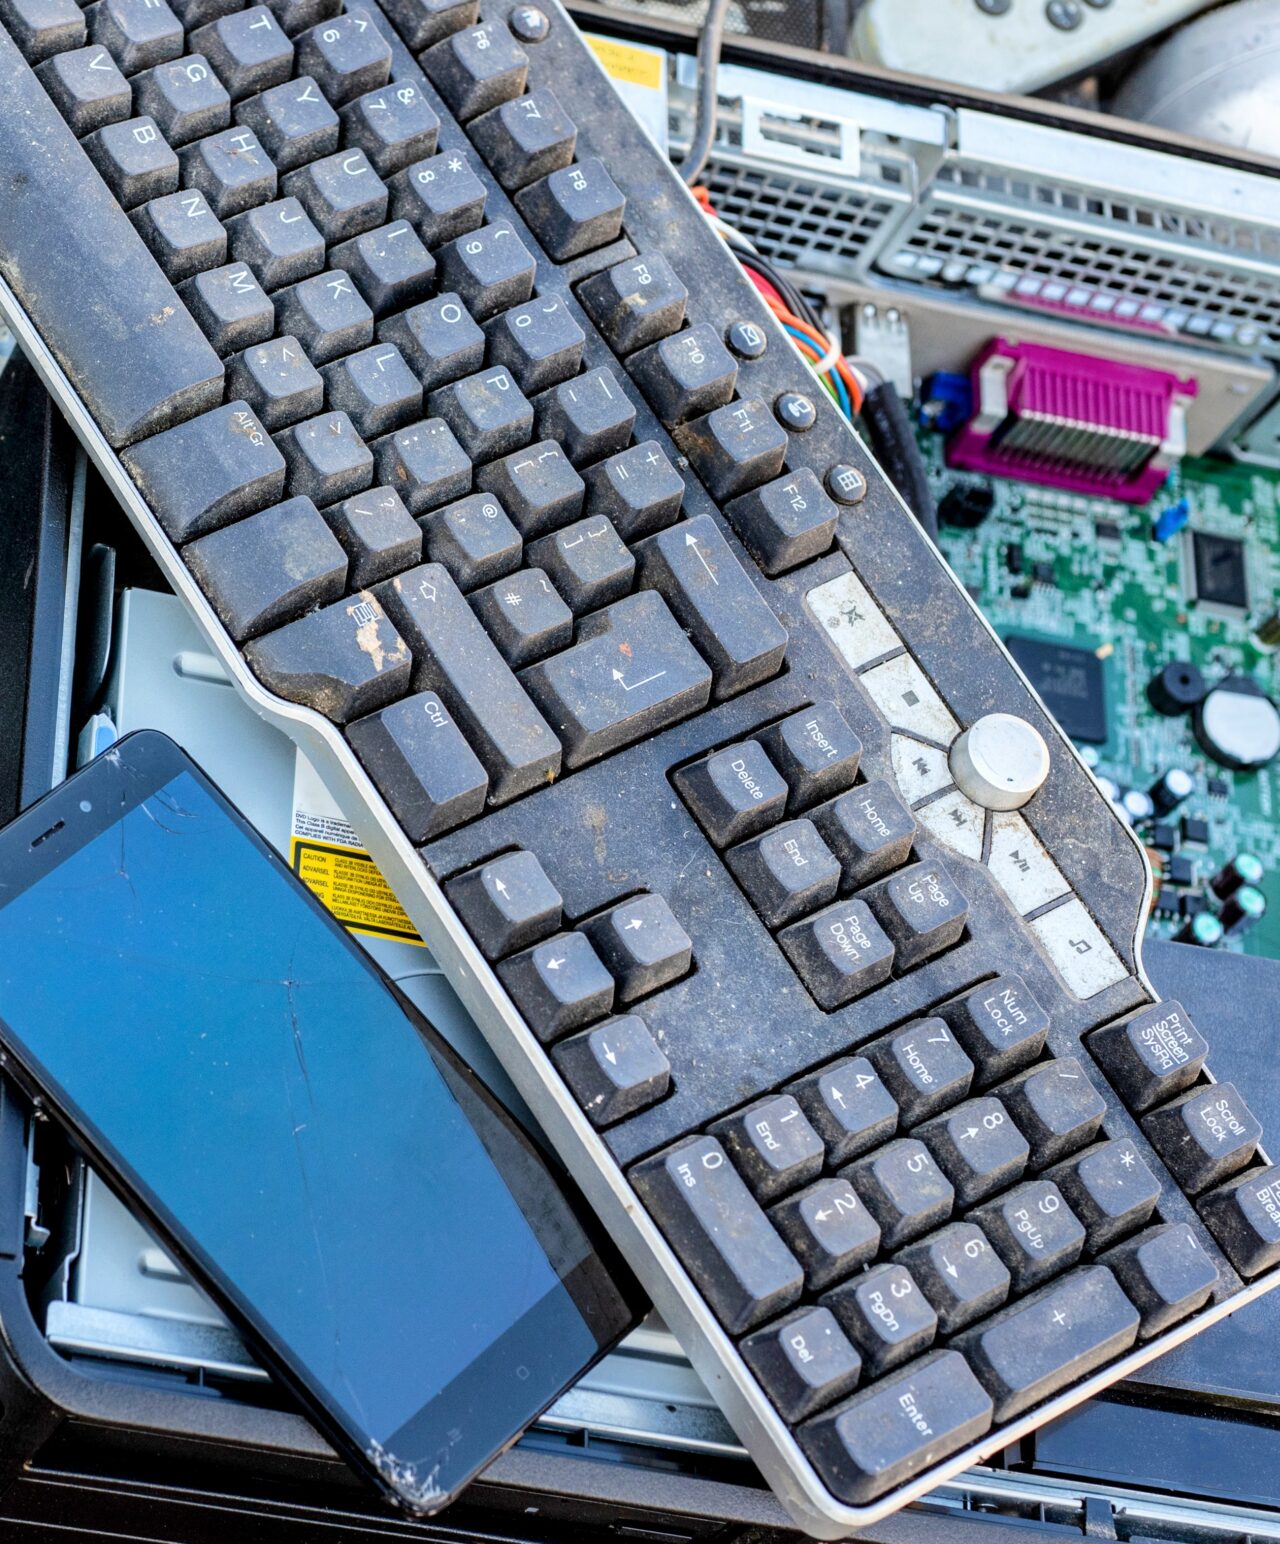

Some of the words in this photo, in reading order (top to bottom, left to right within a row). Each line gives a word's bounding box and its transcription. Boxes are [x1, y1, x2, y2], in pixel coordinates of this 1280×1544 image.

[250, 14, 272, 30] T
[323, 29, 340, 42] 6
[472, 30, 490, 49] F6
[88, 53, 112, 72] V
[186, 64, 207, 82] G
[296, 86, 319, 102] Y
[369, 98, 387, 109] 7
[397, 88, 414, 105] &
[520, 99, 541, 118] F7
[132, 125, 156, 144] B
[230, 133, 256, 152] H
[343, 156, 367, 175] U
[418, 170, 435, 183] 8
[568, 170, 587, 190] F8
[181, 197, 206, 219] N
[280, 211, 302, 223] J
[466, 241, 482, 254] 9
[228, 270, 256, 294] M
[632, 264, 652, 284] F9
[327, 278, 352, 300] K
[682, 336, 705, 364] F10
[376, 353, 395, 372] L
[486, 374, 510, 390] P
[234, 412, 254, 429] Alt
[250, 432, 264, 446] Gr
[732, 408, 754, 432] F11
[783, 484, 807, 512] F12
[482, 504, 498, 518] @
[504, 592, 522, 606] #
[424, 701, 448, 728] Ctrl
[803, 720, 838, 758] Insert
[731, 759, 763, 799] Delete
[860, 799, 891, 839] Home
[303, 853, 326, 863] CAUTION
[784, 839, 808, 866] End
[303, 865, 330, 876] ADVARSEL
[908, 882, 924, 903] Up
[922, 875, 949, 907] Page
[830, 920, 862, 960] Down
[844, 915, 871, 949] Page
[984, 998, 1013, 1036] Lock
[997, 989, 1027, 1028] Num
[927, 1028, 950, 1042] 7
[1166, 1013, 1193, 1045] Print
[1142, 1028, 1173, 1069] SysRq
[1156, 1020, 1190, 1062] Screen
[902, 1044, 933, 1084] Home
[856, 1074, 874, 1089] 4
[780, 1110, 798, 1122] 1
[983, 1112, 1004, 1129] 8
[1200, 1107, 1227, 1141] Lock
[1216, 1100, 1246, 1136] Scroll
[756, 1121, 780, 1150] End
[907, 1153, 928, 1172] 5
[677, 1163, 696, 1187] Ins
[834, 1193, 856, 1215] 2
[1038, 1195, 1059, 1214] 9
[1014, 1209, 1044, 1248] PgUp
[964, 1239, 985, 1258] 6
[891, 1279, 912, 1298] 3
[869, 1291, 899, 1331] PgDn
[791, 1335, 814, 1363] Del
[899, 1393, 932, 1436] Enter
